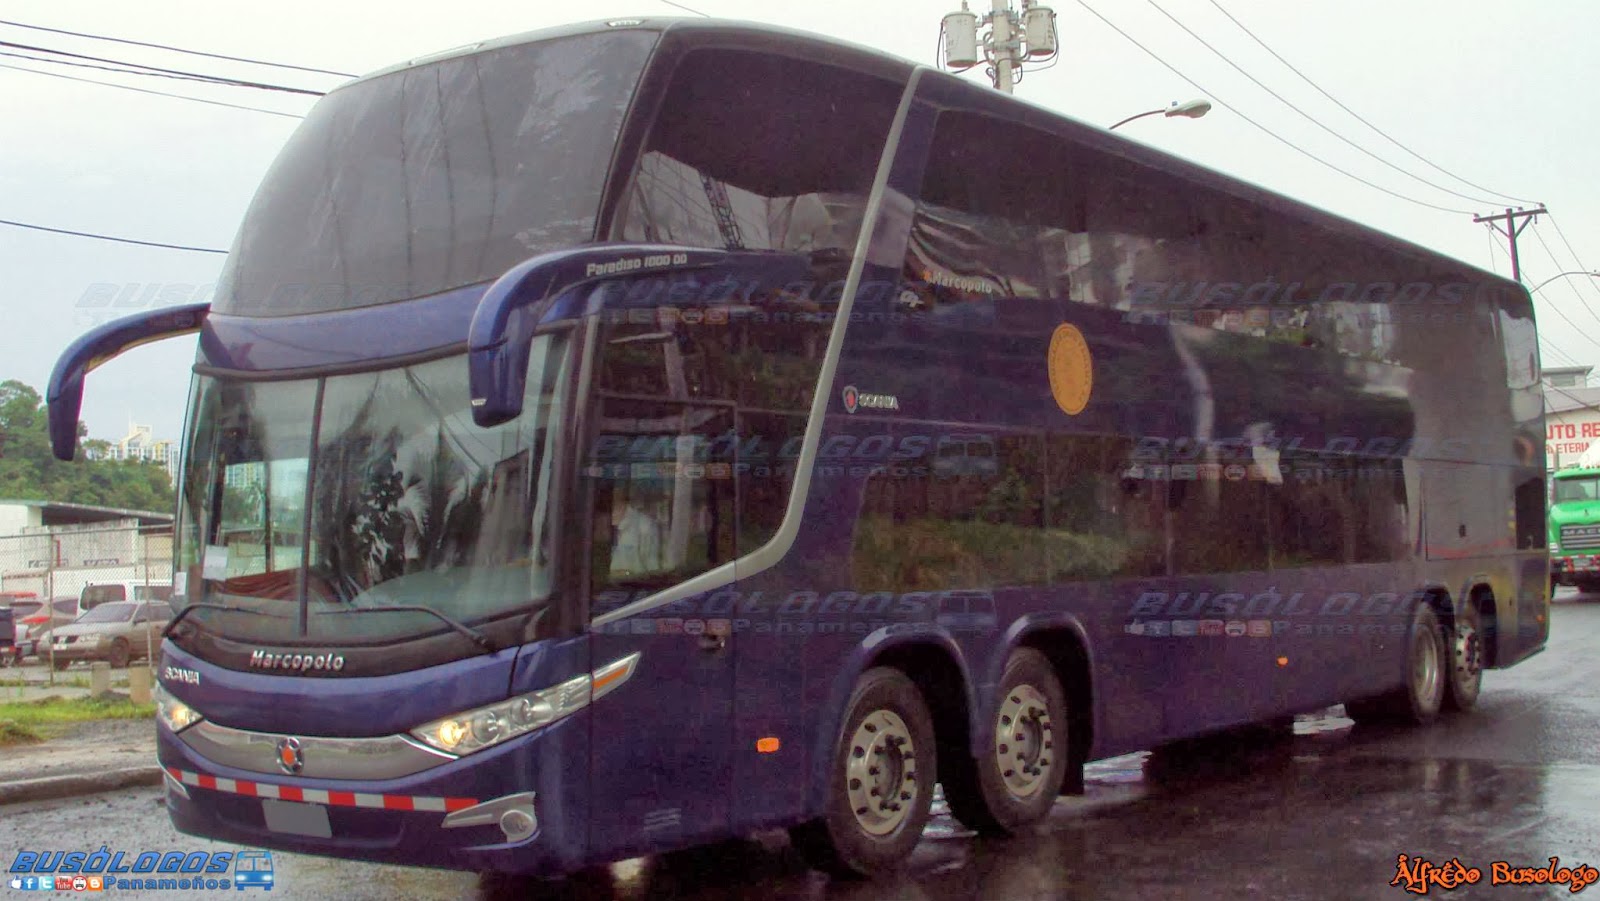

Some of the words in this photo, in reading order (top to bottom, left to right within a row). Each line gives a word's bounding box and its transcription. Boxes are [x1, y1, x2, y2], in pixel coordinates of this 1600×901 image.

[586, 258, 641, 277] Paradiso
[644, 254, 671, 268] 1000
[929, 271, 992, 294] Marcopolo
[1562, 528, 1600, 536] MAC
[250, 649, 345, 672] Marcopolo
[164, 666, 200, 685] SCANIA
